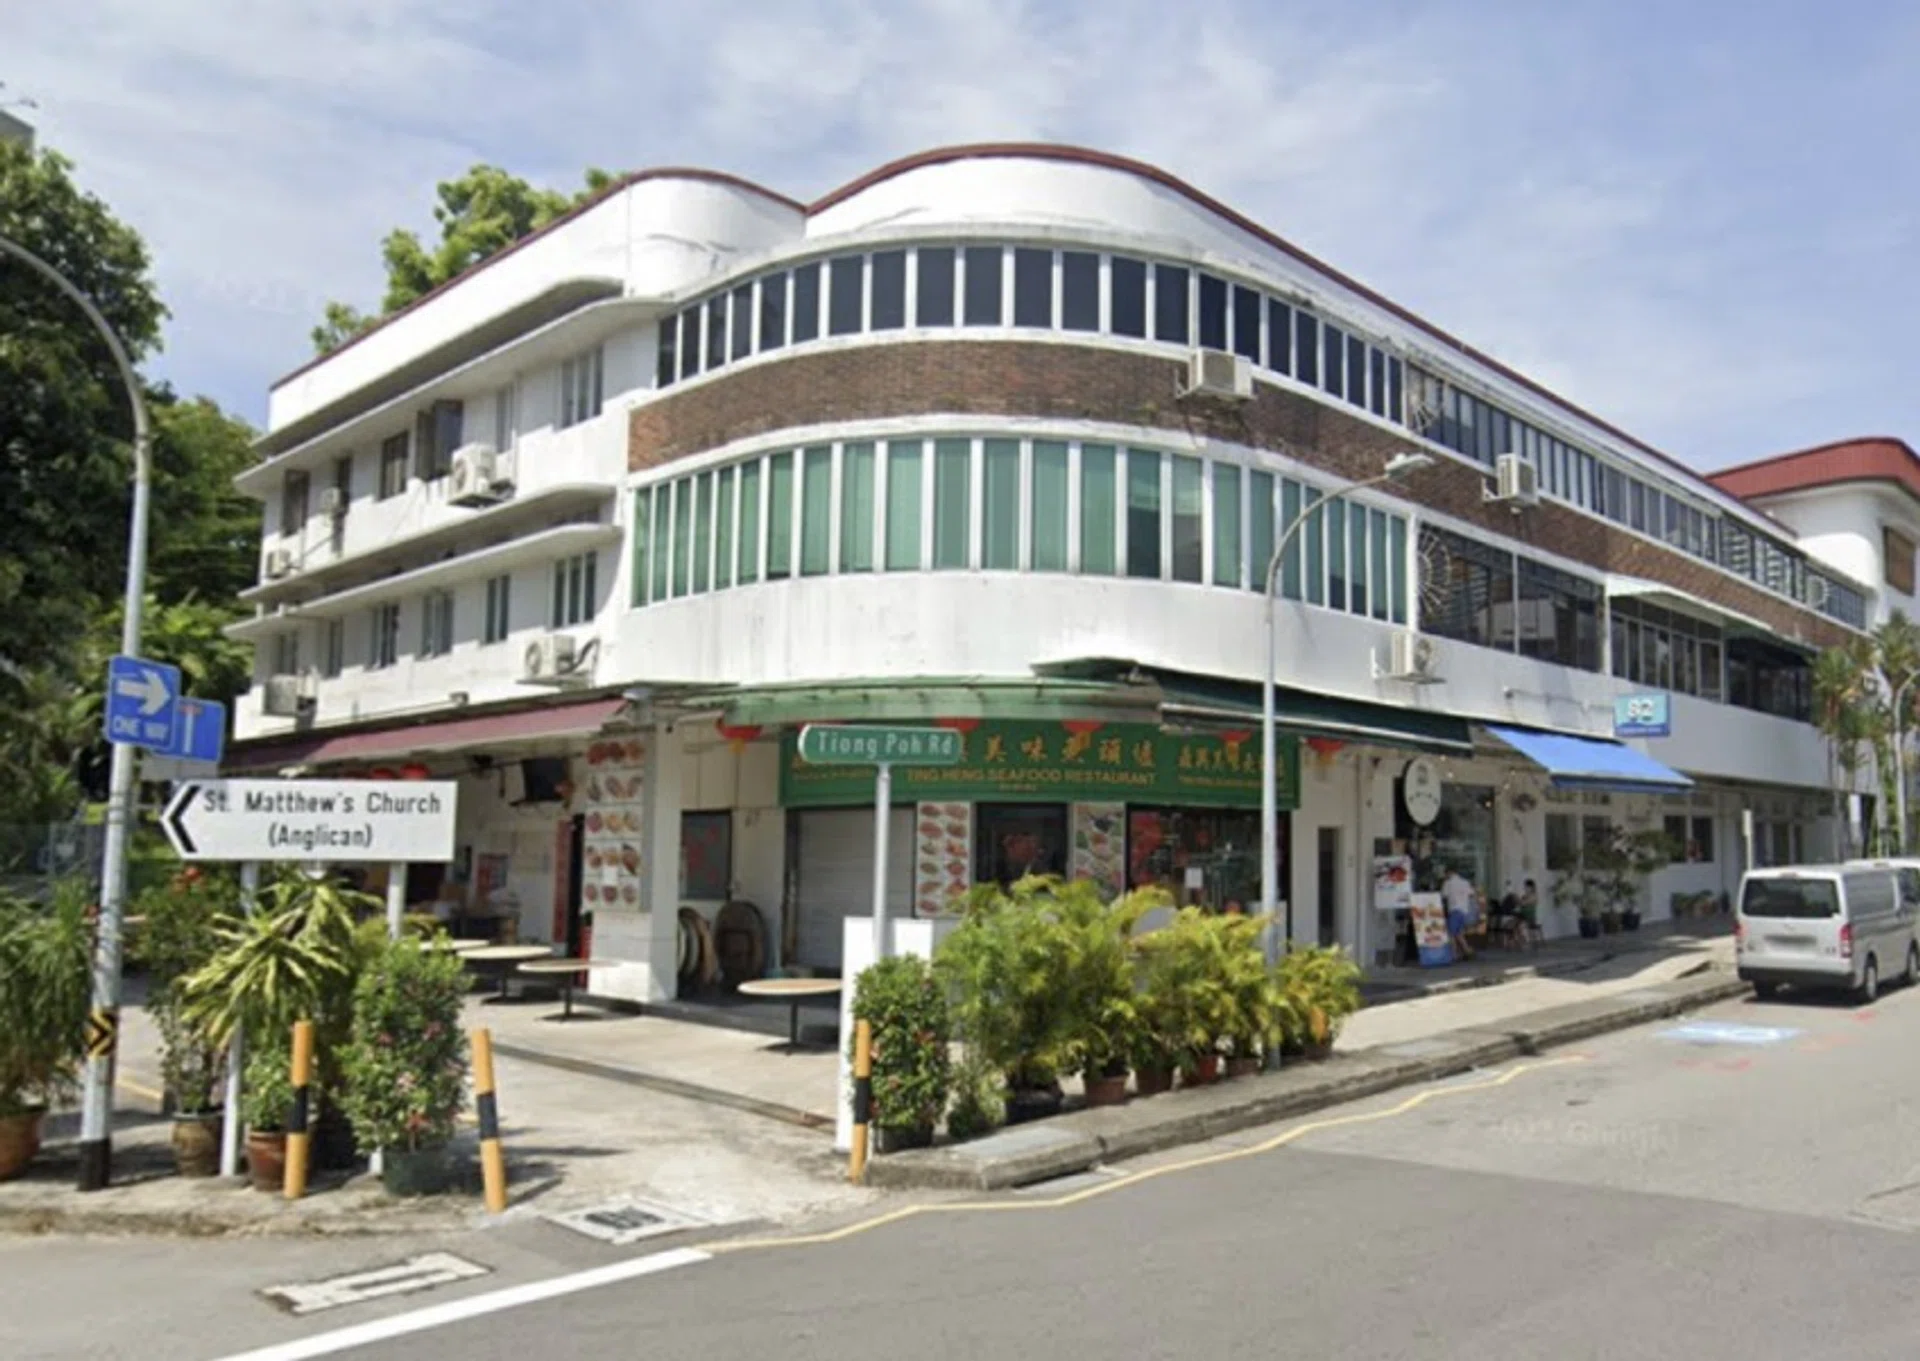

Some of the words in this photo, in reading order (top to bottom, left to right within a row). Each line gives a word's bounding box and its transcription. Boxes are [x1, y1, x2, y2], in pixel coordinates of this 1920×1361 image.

[112, 715, 139, 737] ONE
[818, 731, 878, 760] Tiong
[885, 732, 923, 755] Poh
[928, 733, 953, 755] Rd
[943, 768, 984, 783] HENG
[987, 768, 1062, 783] SEAFOOD
[1064, 769, 1156, 785] RESTAURANT
[203, 790, 231, 813] St.
[244, 790, 355, 814] Matthew's
[366, 790, 442, 814] Church
[267, 821, 373, 851] (Anglican)
